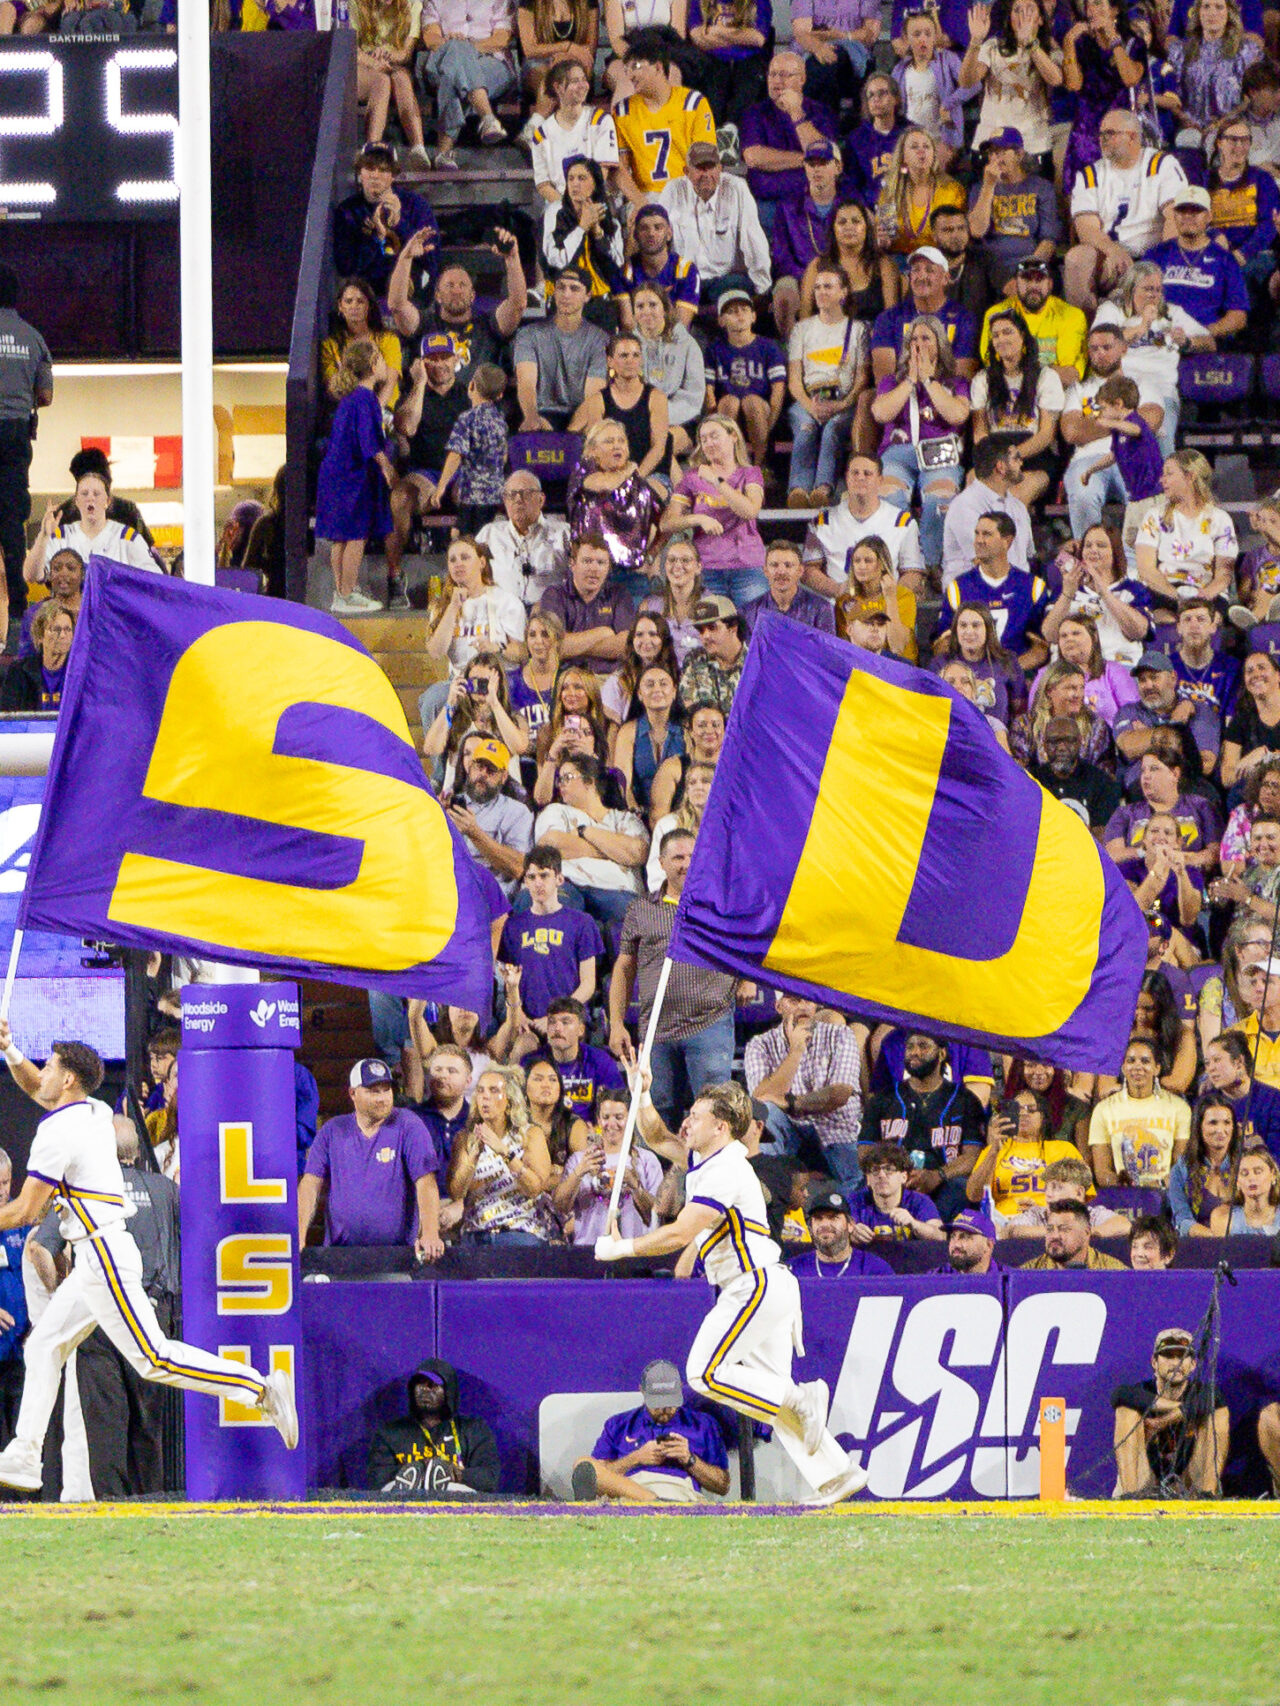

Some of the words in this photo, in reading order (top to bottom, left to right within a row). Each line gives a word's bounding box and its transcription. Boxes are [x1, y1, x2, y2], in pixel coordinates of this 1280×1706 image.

[49, 35, 120, 43] DAKTRONICS
[644, 130, 671, 181] 7
[717, 357, 764, 380] LSU
[1194, 371, 1233, 385] LSU
[526, 449, 564, 464] LSU
[109, 621, 458, 972] S
[764, 670, 1103, 1037] U
[522, 928, 564, 948] LSU
[185, 1016, 216, 1032] Energy
[217, 1121, 296, 1428] LSU
